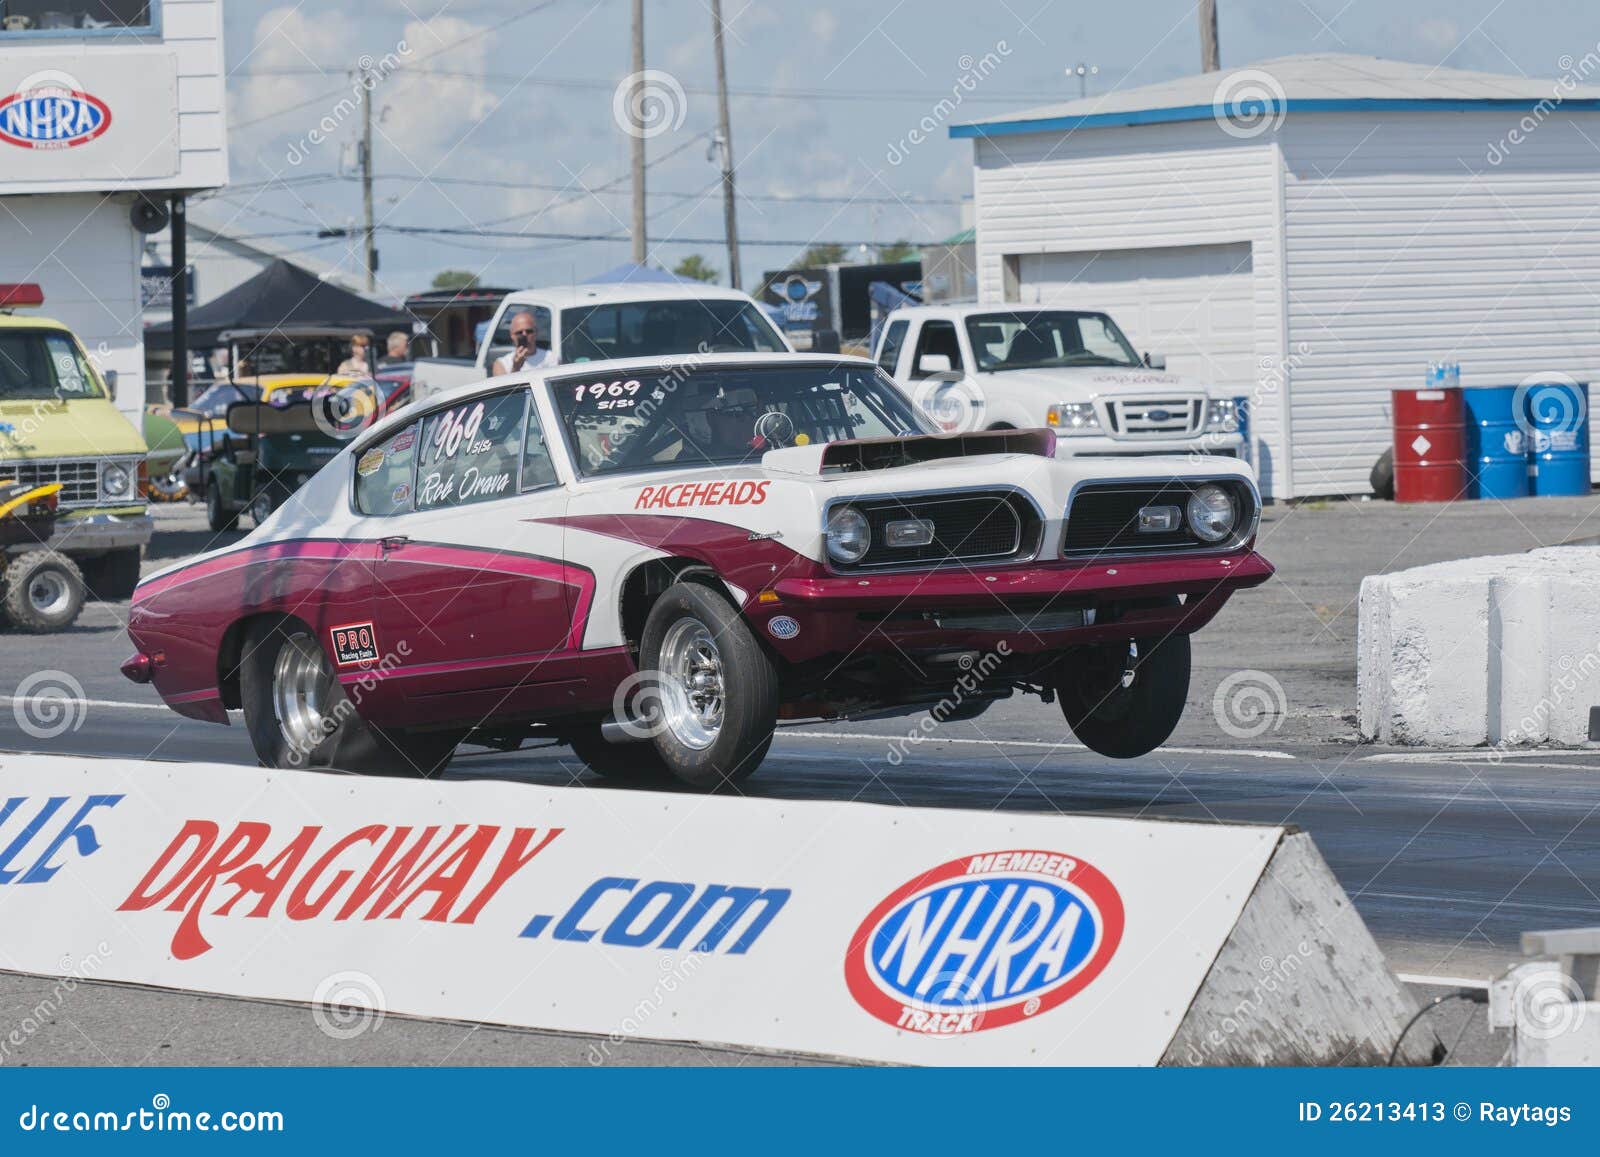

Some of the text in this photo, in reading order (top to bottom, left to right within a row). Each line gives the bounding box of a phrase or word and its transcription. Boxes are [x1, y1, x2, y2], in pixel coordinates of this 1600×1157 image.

[6, 98, 95, 139] NHRA
[574, 380, 641, 402] 1969
[420, 402, 485, 463] 1969
[418, 472, 454, 505] Rob
[634, 480, 772, 510] RACEHEADS
[337, 628, 370, 652] PRO
[966, 852, 1077, 880] MEMBER
[115, 819, 565, 961] DRAGWAY
[518, 876, 792, 955] .com
[878, 883, 1083, 999] NHRA
[897, 1005, 978, 1034] TRACK
